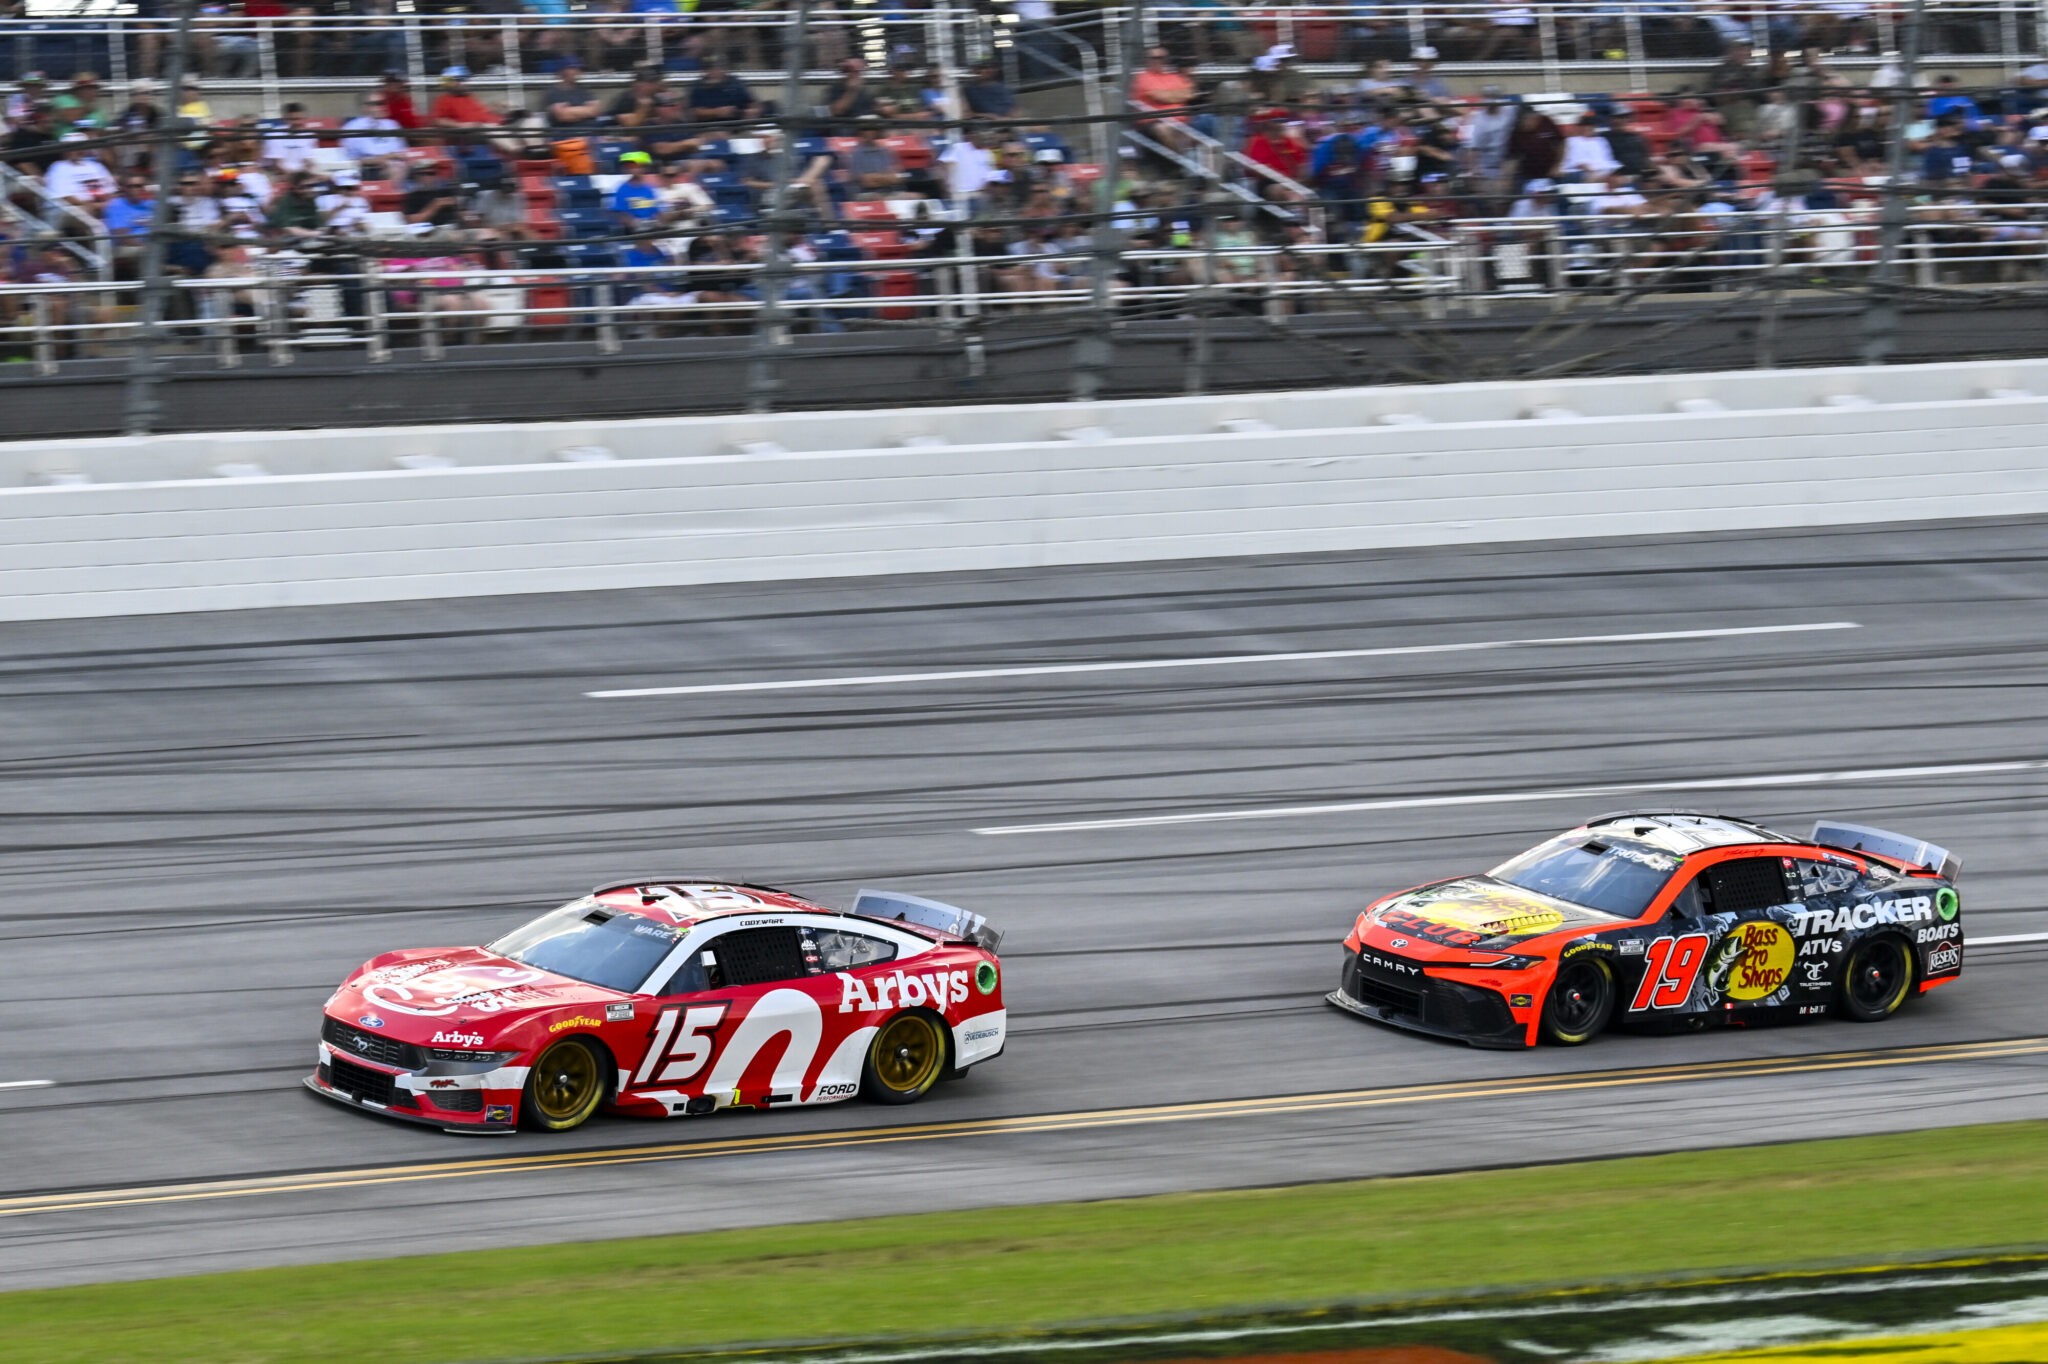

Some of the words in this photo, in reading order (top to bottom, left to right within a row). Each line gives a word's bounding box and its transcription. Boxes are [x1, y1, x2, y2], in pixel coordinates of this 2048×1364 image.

[740, 919, 760, 927] CODY
[1793, 896, 1932, 937] TRACKER
[634, 924, 670, 939] WARE
[1381, 911, 1482, 945] CLUB
[1742, 924, 1779, 947] Bass
[1916, 923, 1960, 944] BOATS
[1564, 941, 1613, 958] GOODYEAR
[1741, 945, 1769, 968] Pro
[1798, 938, 1843, 956] ATVs
[1363, 953, 1420, 976] CAMRY
[1629, 933, 1711, 1012] 19
[1737, 965, 1783, 992] Shops
[548, 1016, 602, 1032] GOODYEAR
[431, 1031, 485, 1048] Arby's
[628, 1000, 733, 1088] 15
[818, 1083, 857, 1096] FORD
